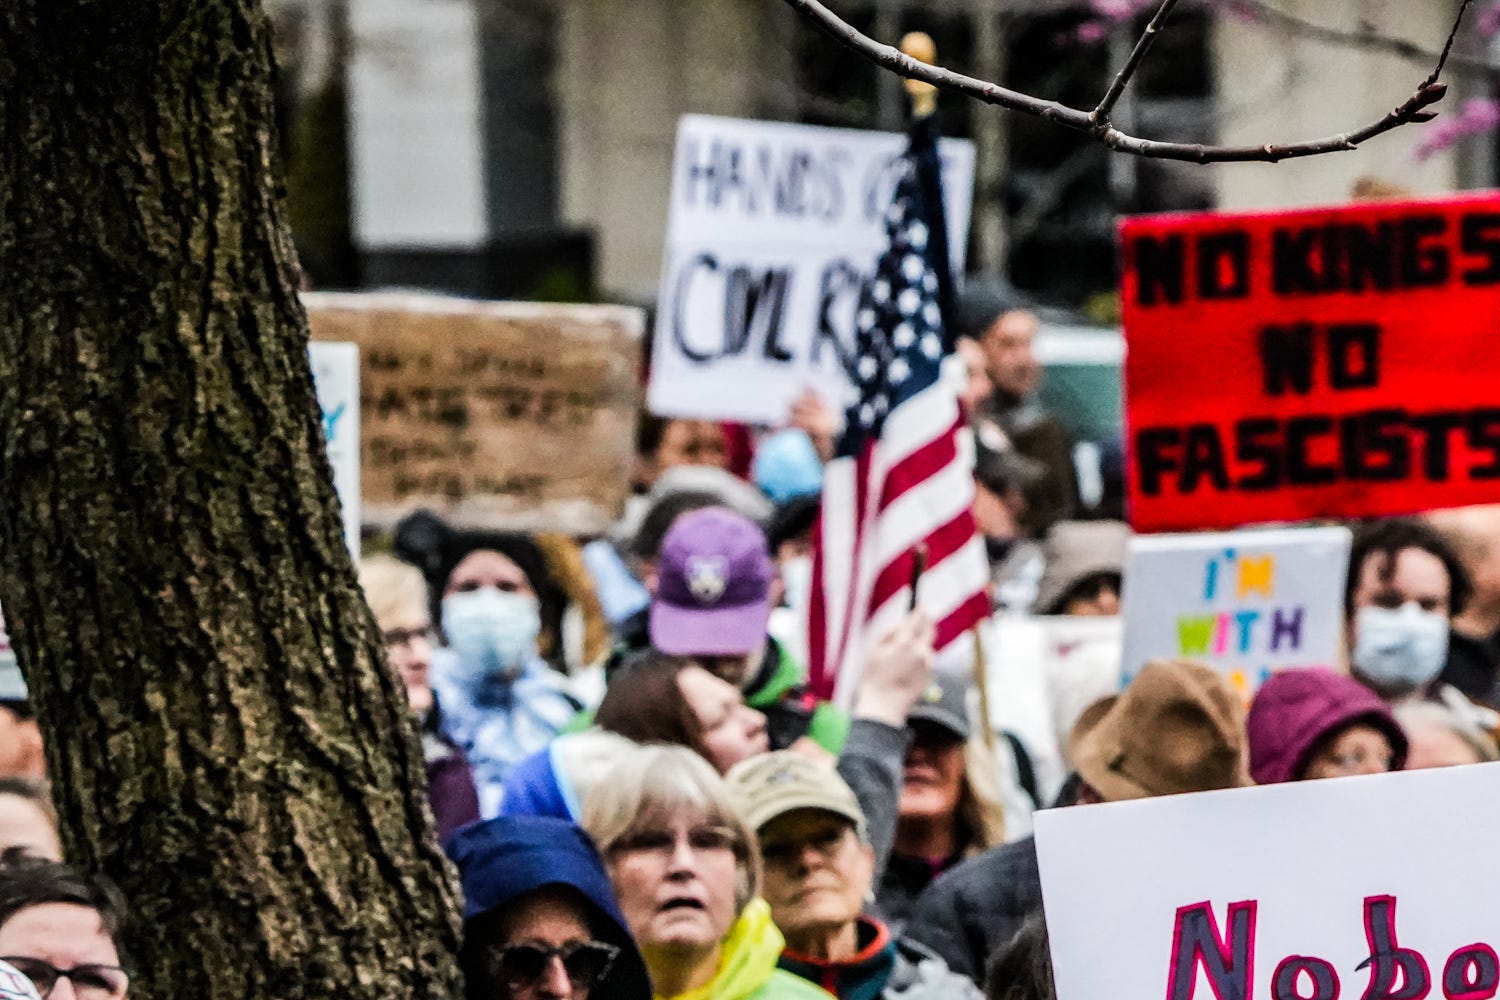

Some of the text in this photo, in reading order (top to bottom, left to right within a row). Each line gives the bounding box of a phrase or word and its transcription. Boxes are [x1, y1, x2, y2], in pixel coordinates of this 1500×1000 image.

[1134, 230, 1250, 306] NO
[1259, 321, 1381, 396] NO
[1203, 548, 1276, 600] I'M
[1176, 606, 1304, 657] WITH
